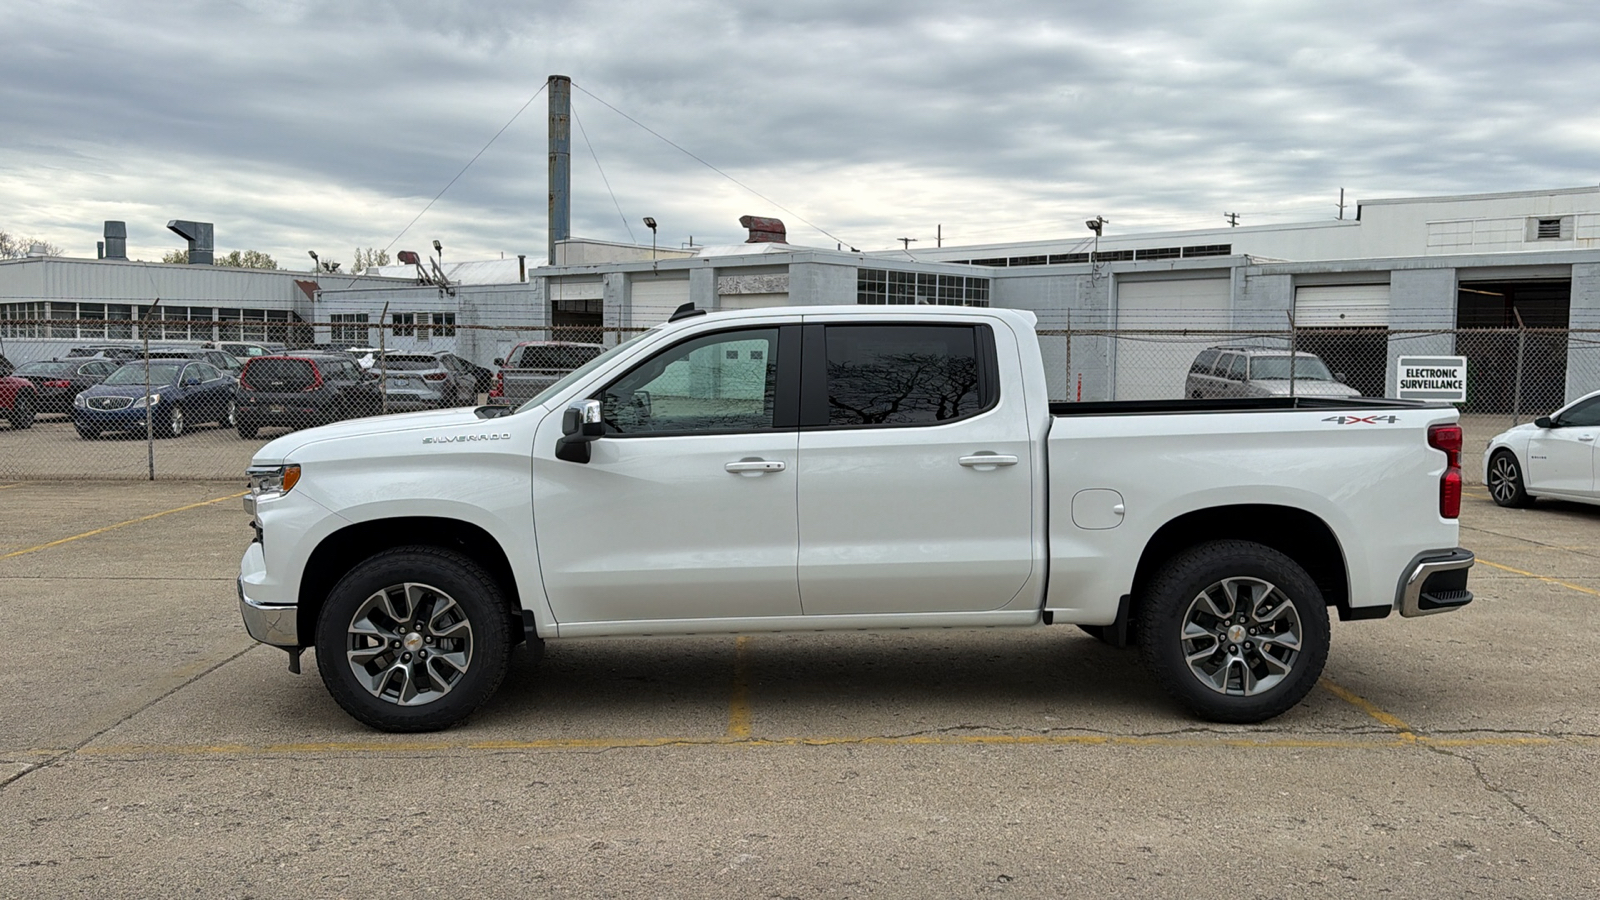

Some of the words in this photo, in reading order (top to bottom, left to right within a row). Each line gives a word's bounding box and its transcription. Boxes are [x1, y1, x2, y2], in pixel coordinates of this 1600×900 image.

[1406, 368, 1457, 378] ELECTRONIC
[1400, 379, 1463, 389] SURVEILLANCE
[422, 433, 511, 444] SILVERADO
